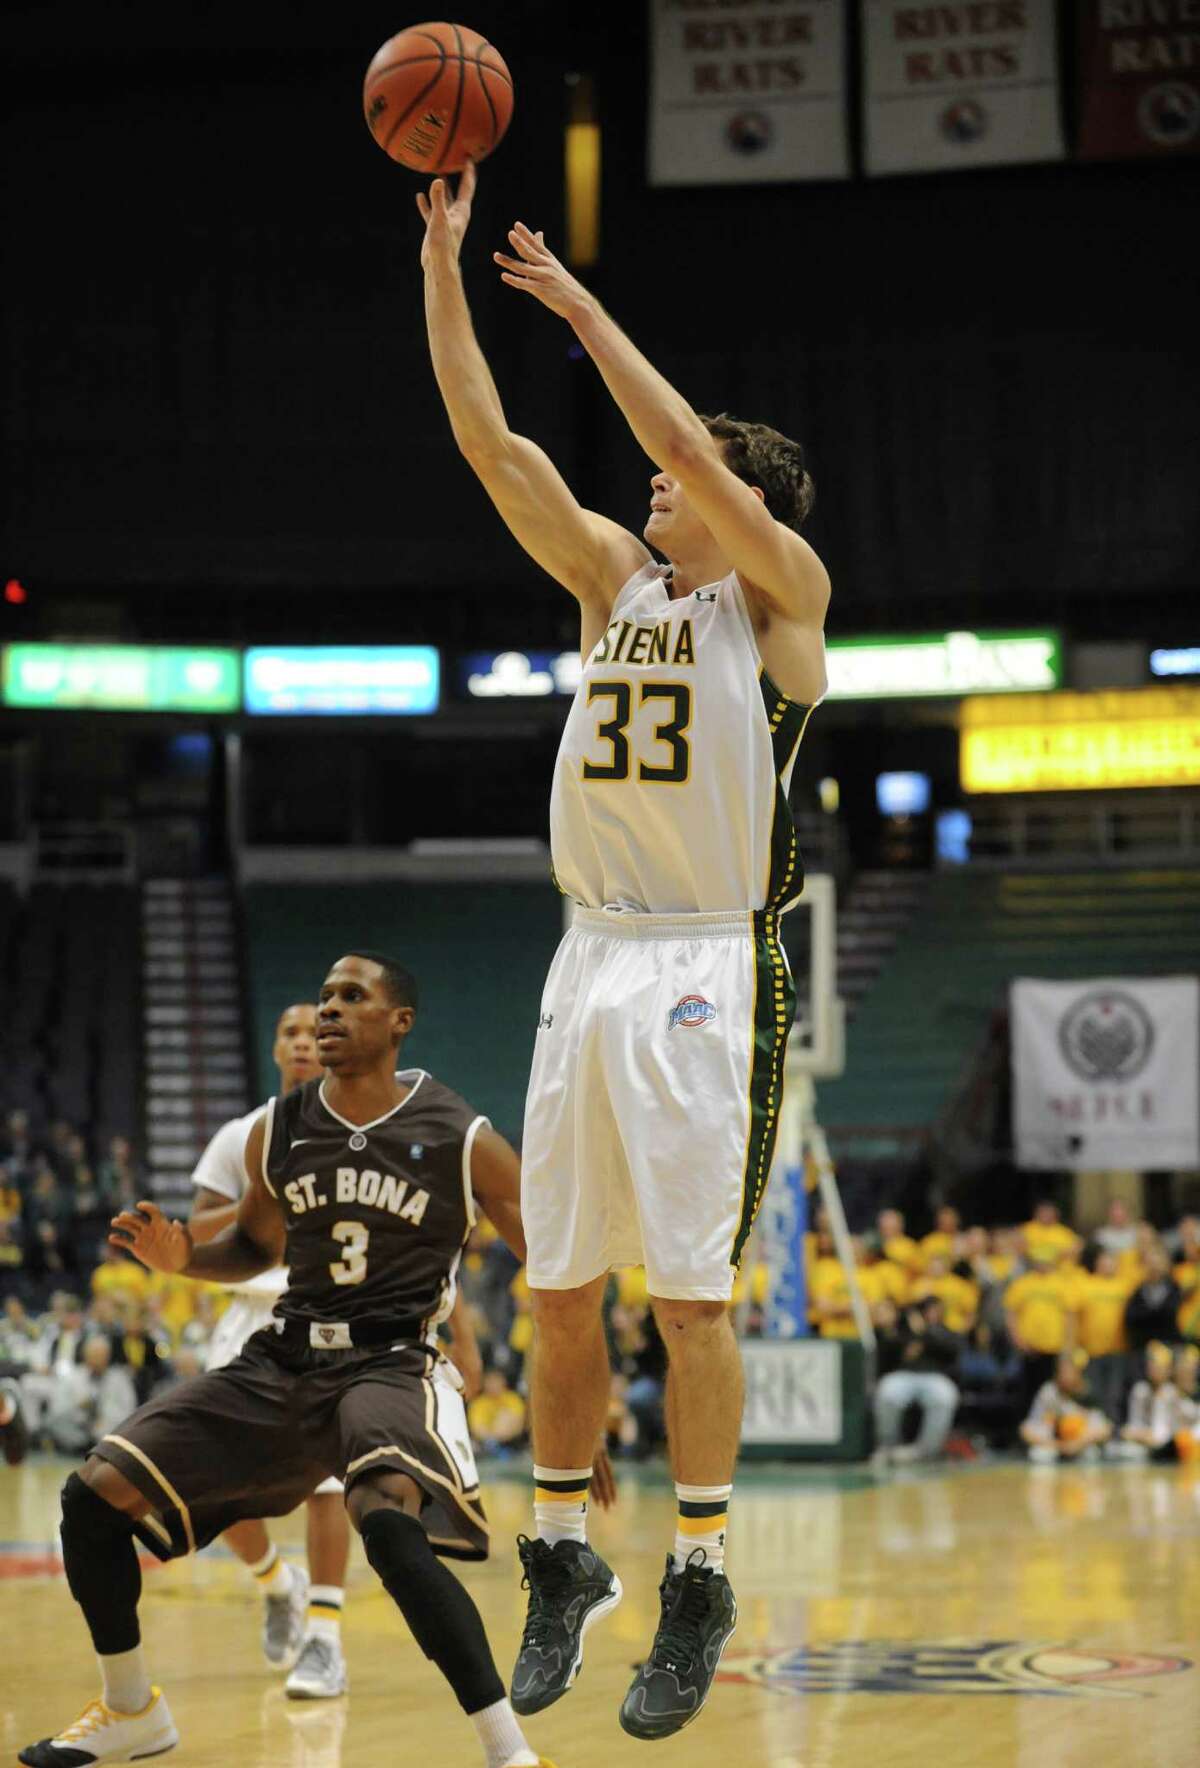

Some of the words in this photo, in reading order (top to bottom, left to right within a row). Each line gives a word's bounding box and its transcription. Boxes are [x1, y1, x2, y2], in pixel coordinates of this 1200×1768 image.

[683, 14, 813, 51] RIVER
[894, 4, 1026, 41] RIVER
[1099, 0, 1200, 28] RIVE
[905, 47, 1019, 82] RATS
[1110, 33, 1200, 72] RAT
[694, 57, 807, 94] RATS
[593, 617, 696, 665] SIENA
[581, 679, 695, 786] 33
[284, 1173, 328, 1214] ST.
[336, 1167, 431, 1226] BONA
[329, 1221, 369, 1285] 3
[745, 1355, 821, 1425] RK
